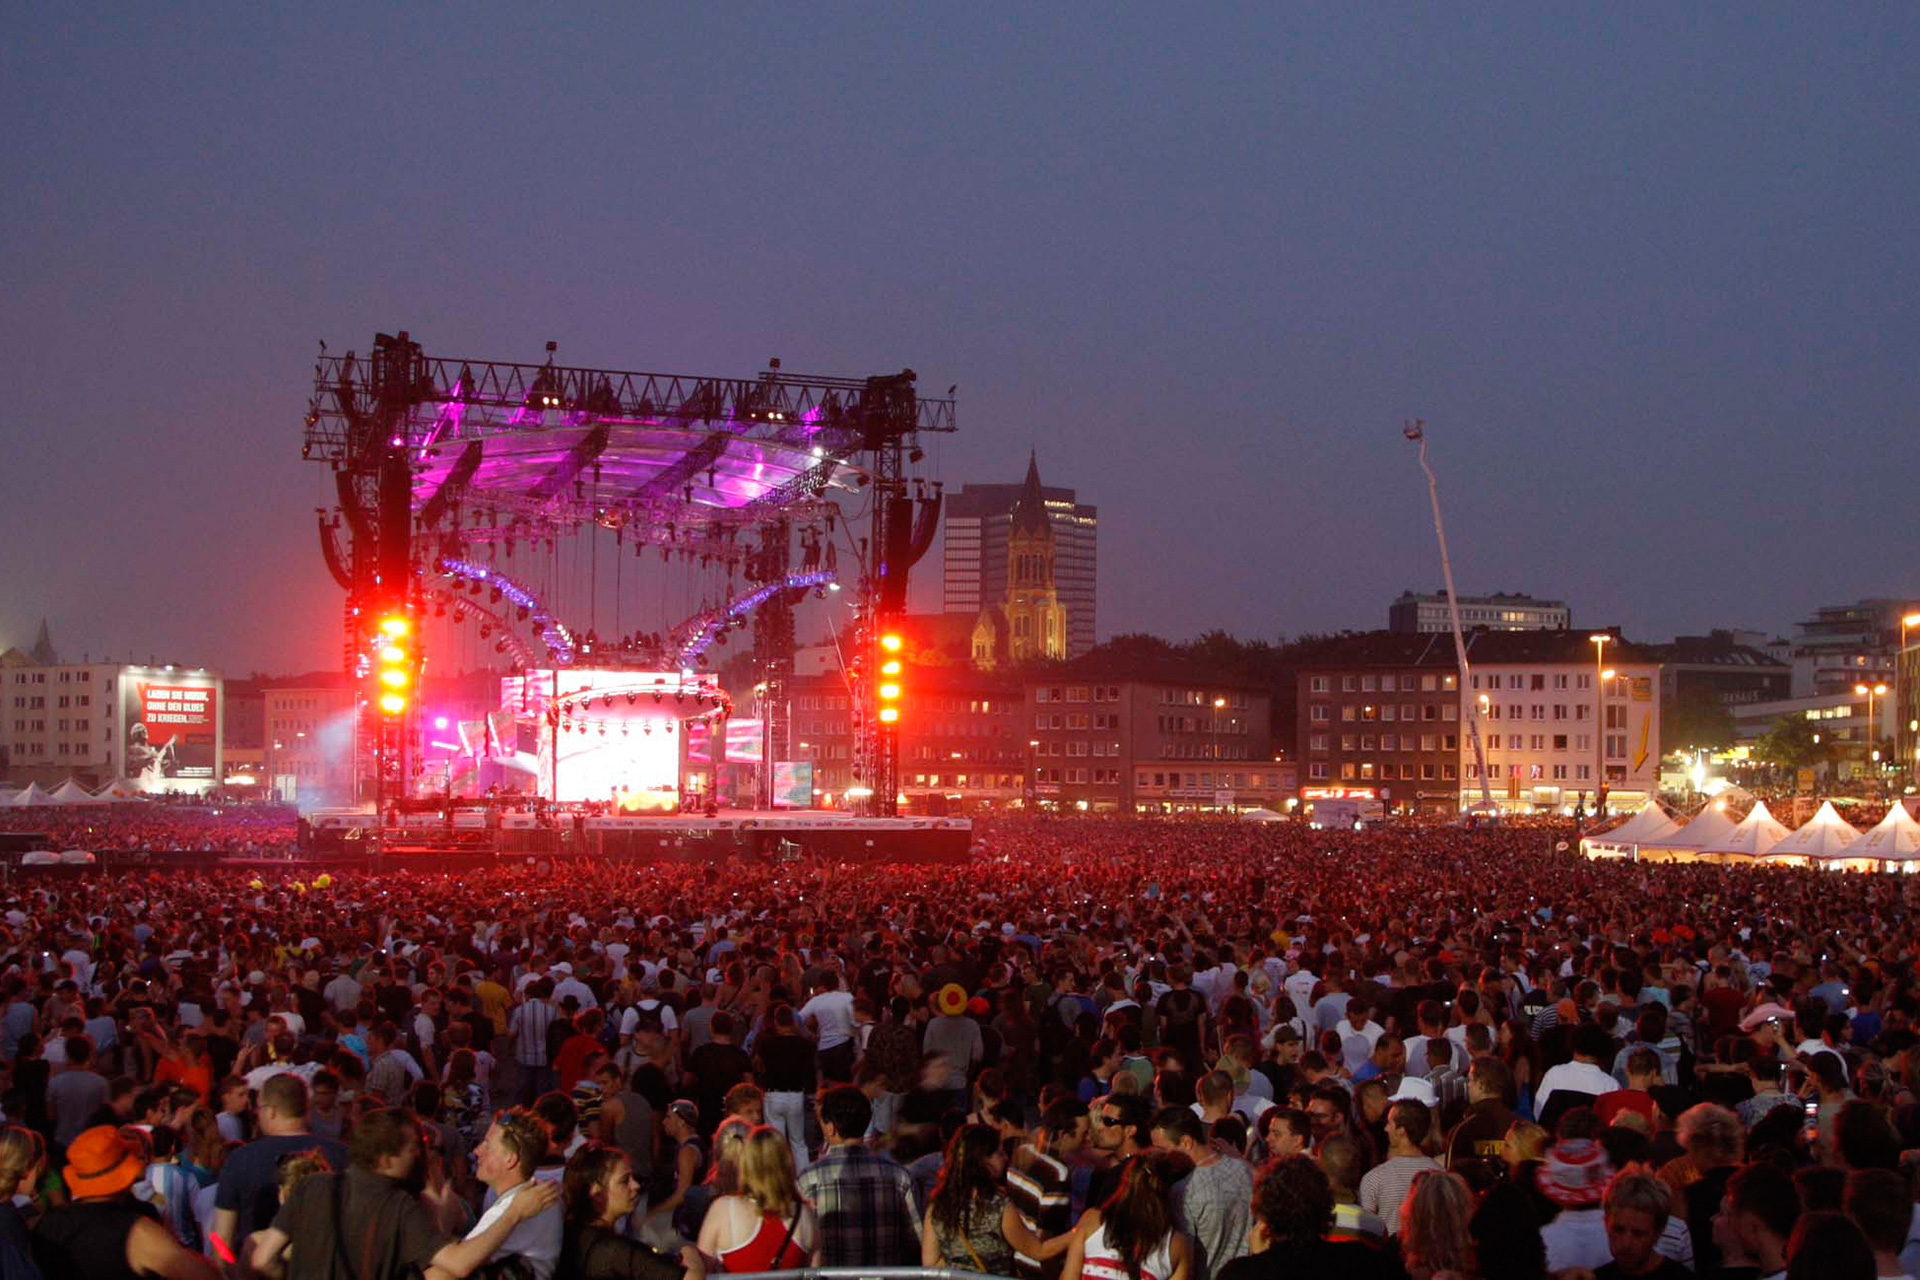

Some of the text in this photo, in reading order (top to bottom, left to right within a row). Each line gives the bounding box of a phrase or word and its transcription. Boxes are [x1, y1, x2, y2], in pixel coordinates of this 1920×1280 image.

[167, 702, 182, 711] DEN
[183, 703, 204, 712] BLUES
[146, 713, 156, 722] ZU
